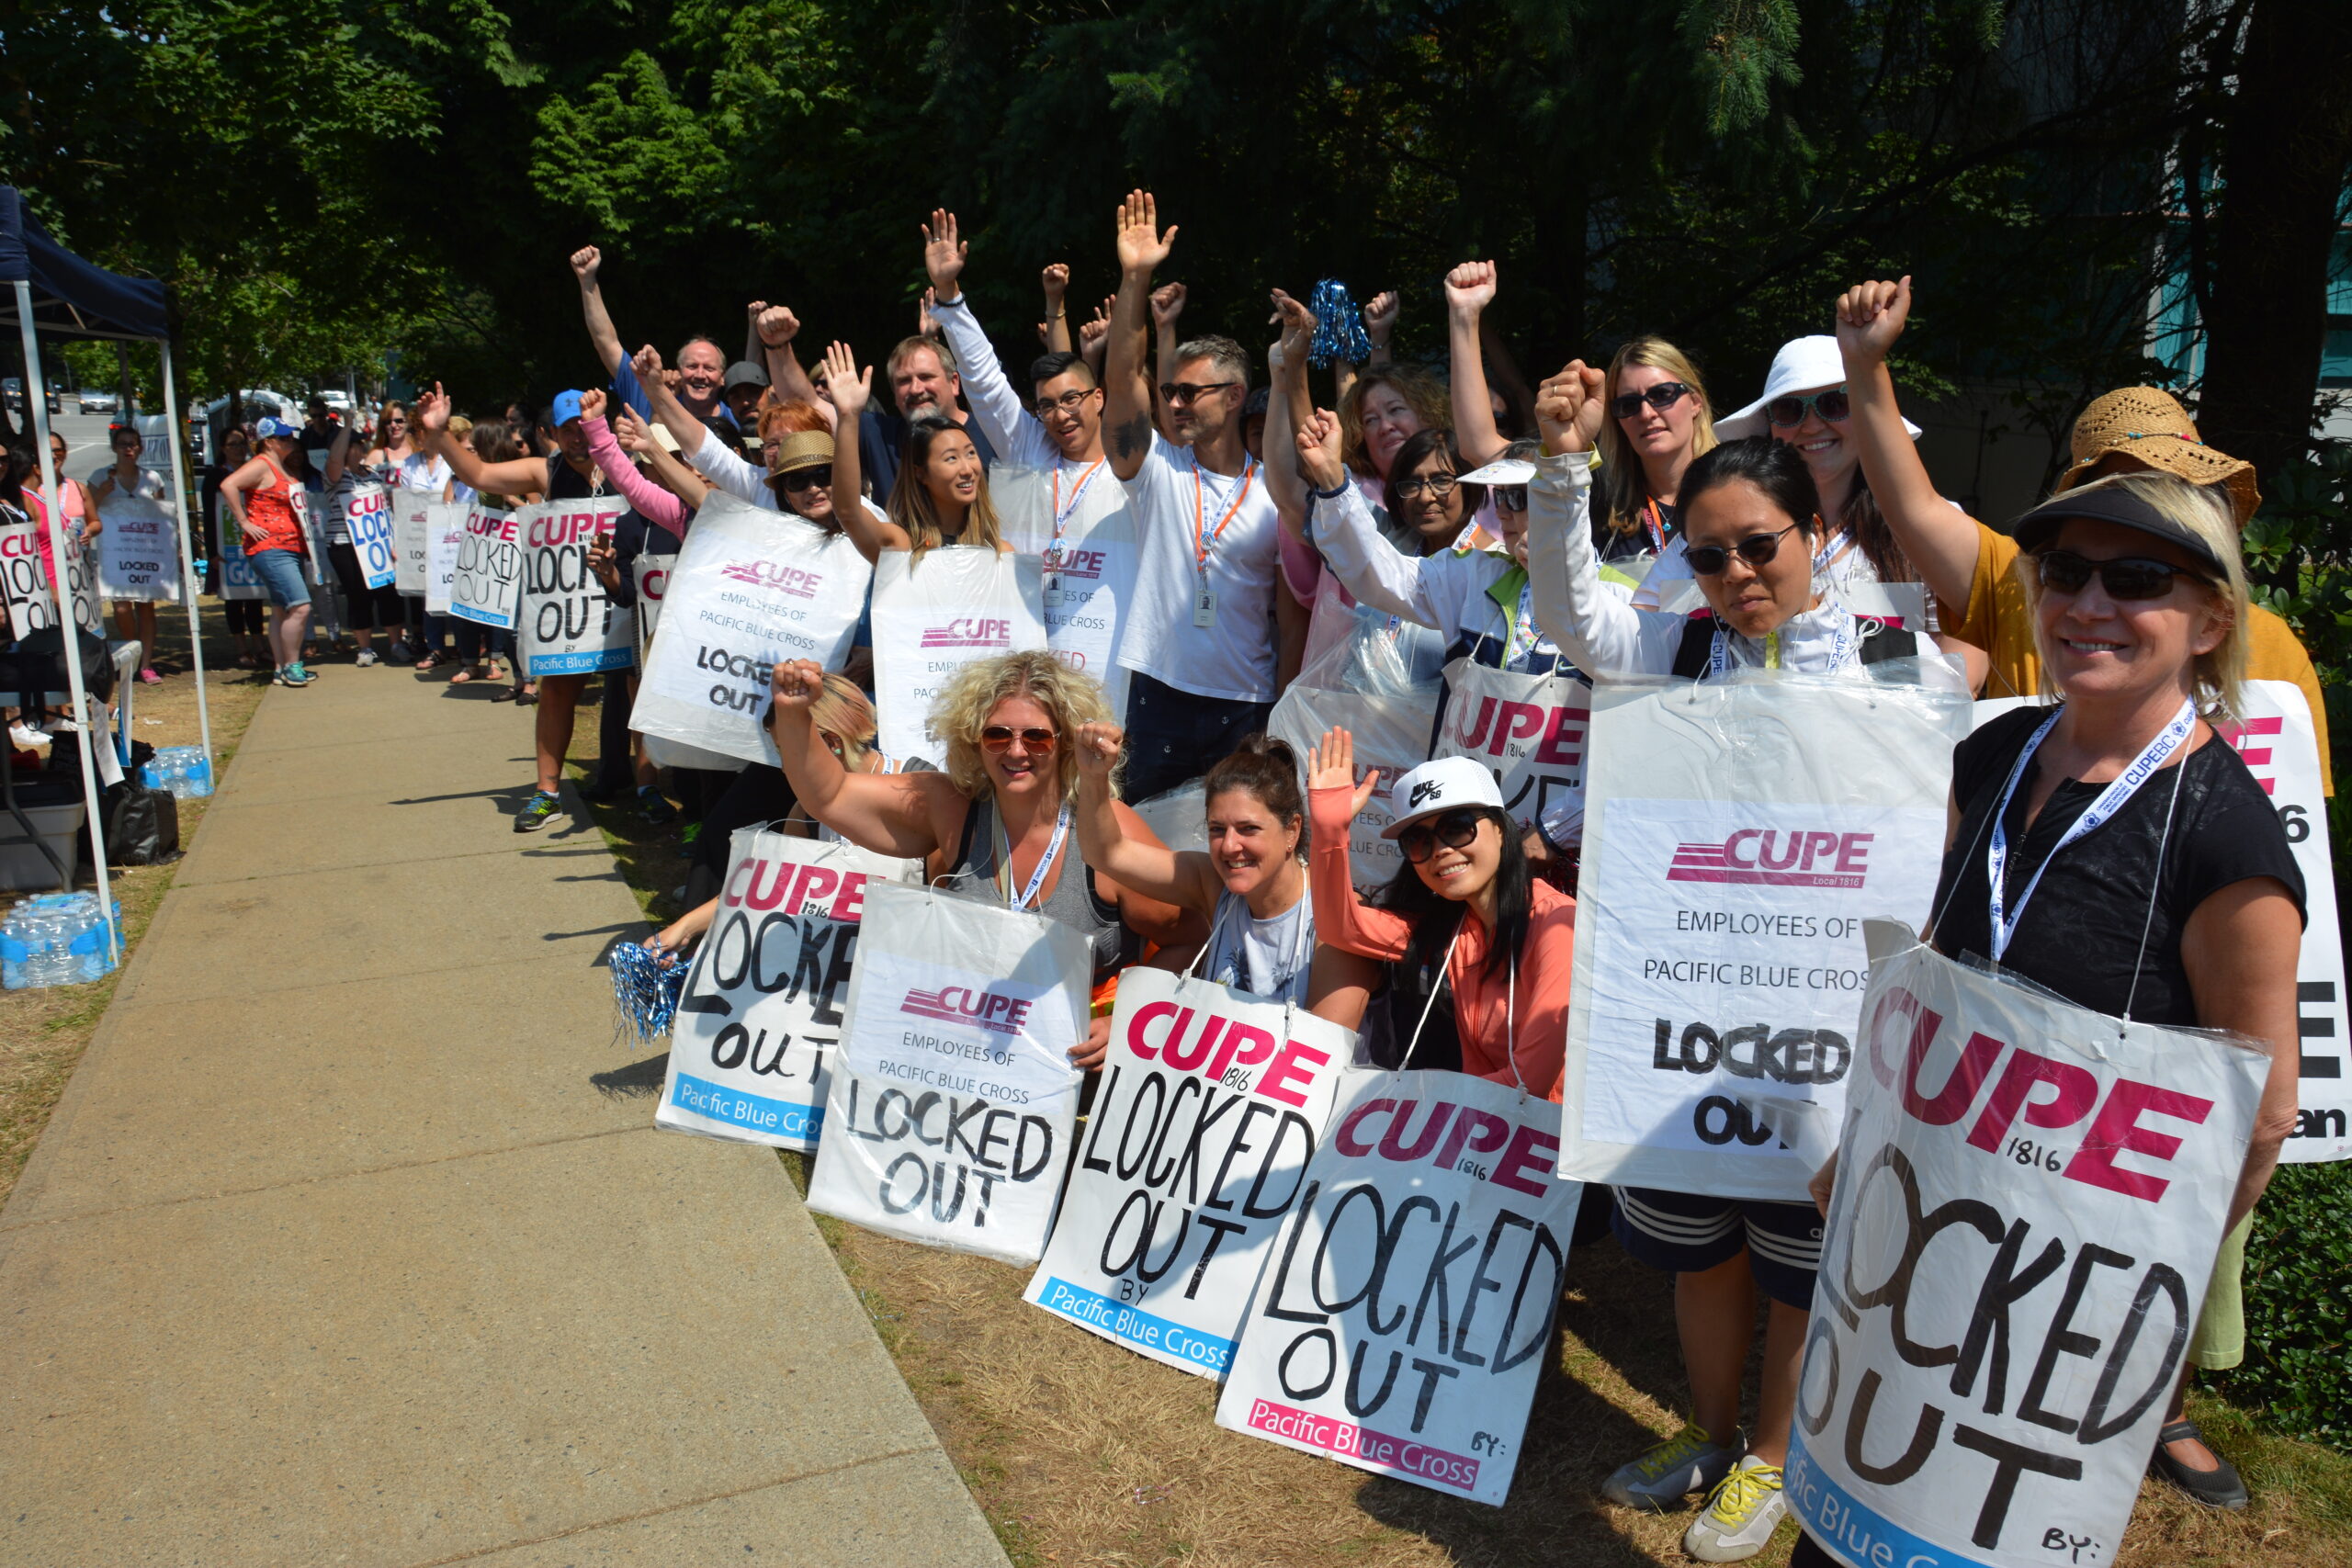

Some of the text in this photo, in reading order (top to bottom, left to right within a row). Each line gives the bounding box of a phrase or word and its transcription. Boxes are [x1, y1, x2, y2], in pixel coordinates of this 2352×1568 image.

[2, 533, 39, 558] CU
[130, 522, 159, 533] CUPE
[467, 513, 519, 542] CUPE
[528, 511, 621, 547] CUPE
[119, 560, 159, 571] LOCKED
[458, 536, 522, 581] LOCKED
[526, 544, 604, 595] LOCK
[752, 560, 822, 592] CUPE
[1043, 548, 1106, 571] CUPE
[129, 574, 152, 584] OUT
[459, 574, 509, 609] OUT
[720, 592, 807, 622] EMPLOYEES OF
[1080, 592, 1094, 603] OF
[537, 595, 614, 643] OUT
[700, 610, 816, 651] PACIFIC BLUE CROSS
[947, 618, 1011, 639] CUPE
[1069, 615, 1105, 630] CROSS
[533, 653, 627, 671] Pacific Blue Cross
[565, 645, 576, 653] BY
[697, 646, 775, 686] LOCKE
[709, 684, 764, 716] OUT
[1507, 743, 1525, 758] 1816
[2125, 734, 2177, 786] CUPEBC
[1413, 780, 1434, 797] NIKE
[1430, 790, 1442, 801] SB
[1350, 840, 1403, 859] LUE CRO
[1724, 828, 1874, 874] CUPE
[724, 857, 885, 922] CUPE
[1813, 875, 1860, 886] Local 1816
[801, 901, 829, 919] 1816
[1678, 909, 1858, 939] EMPLOYEES OF
[680, 910, 861, 1027] LOCKE
[1644, 958, 1869, 991] PACIFIC BLUE CROS
[937, 986, 1033, 1027] CUPE
[711, 1022, 839, 1085] OUT
[902, 1032, 1016, 1066] EMPLOYEES OF
[1126, 1000, 1331, 1109] CUPE
[1653, 1017, 1851, 1085] LOCKED
[879, 1060, 1030, 1104] PACIFIC BLUE CROSS
[1220, 1066, 1250, 1092] 1816
[1870, 986, 2214, 1204] CUPE
[681, 1084, 821, 1135] Pacific Blue Cro
[846, 1079, 1053, 1183] LOCKED
[1082, 1064, 1315, 1220] LOCKED
[1335, 1098, 1562, 1198] CUPE
[1458, 1157, 1487, 1182] 1816
[2007, 1136, 2062, 1174] 1816
[879, 1151, 1006, 1227] OUT
[1100, 1189, 1247, 1301] OUT
[1120, 1278, 1148, 1305] BY
[1263, 1179, 1564, 1375] LOCKED
[1816, 1108, 2190, 1444] LOCKED
[1050, 1284, 1229, 1368] Pacific Blue Cross
[1278, 1327, 1460, 1434] OUT
[1253, 1402, 1476, 1486] Pacific Blue Cross
[1471, 1431, 1507, 1459] BY:
[1797, 1315, 2082, 1551] OUT
[1819, 1493, 1894, 1568] Blue
[2041, 1528, 2101, 1564] BY:
